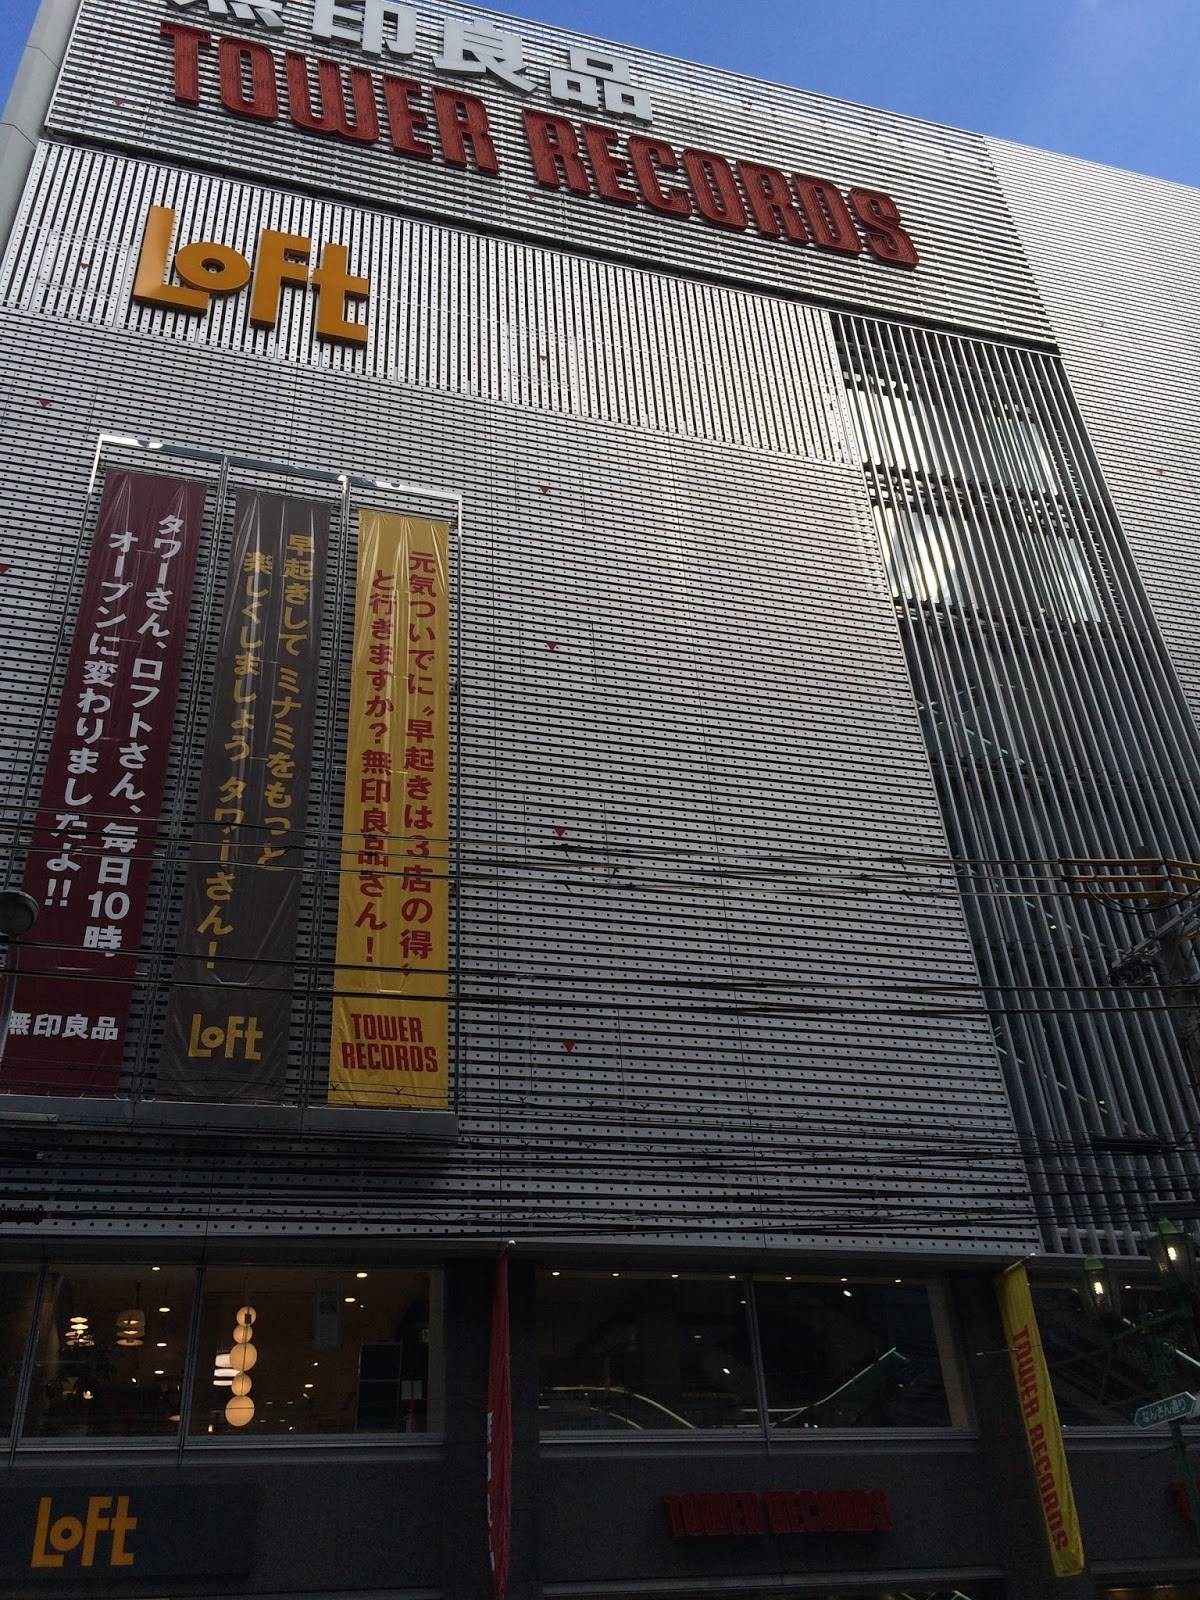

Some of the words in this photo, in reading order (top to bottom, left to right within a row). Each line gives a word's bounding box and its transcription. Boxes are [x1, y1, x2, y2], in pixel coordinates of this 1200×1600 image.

[160, 21, 499, 175] TOWER
[522, 109, 919, 269] RECORDS
[8, 1010, 120, 1041] 無印良品
[351, 1013, 424, 1043] TOWER
[341, 1043, 439, 1073] RECORDS
